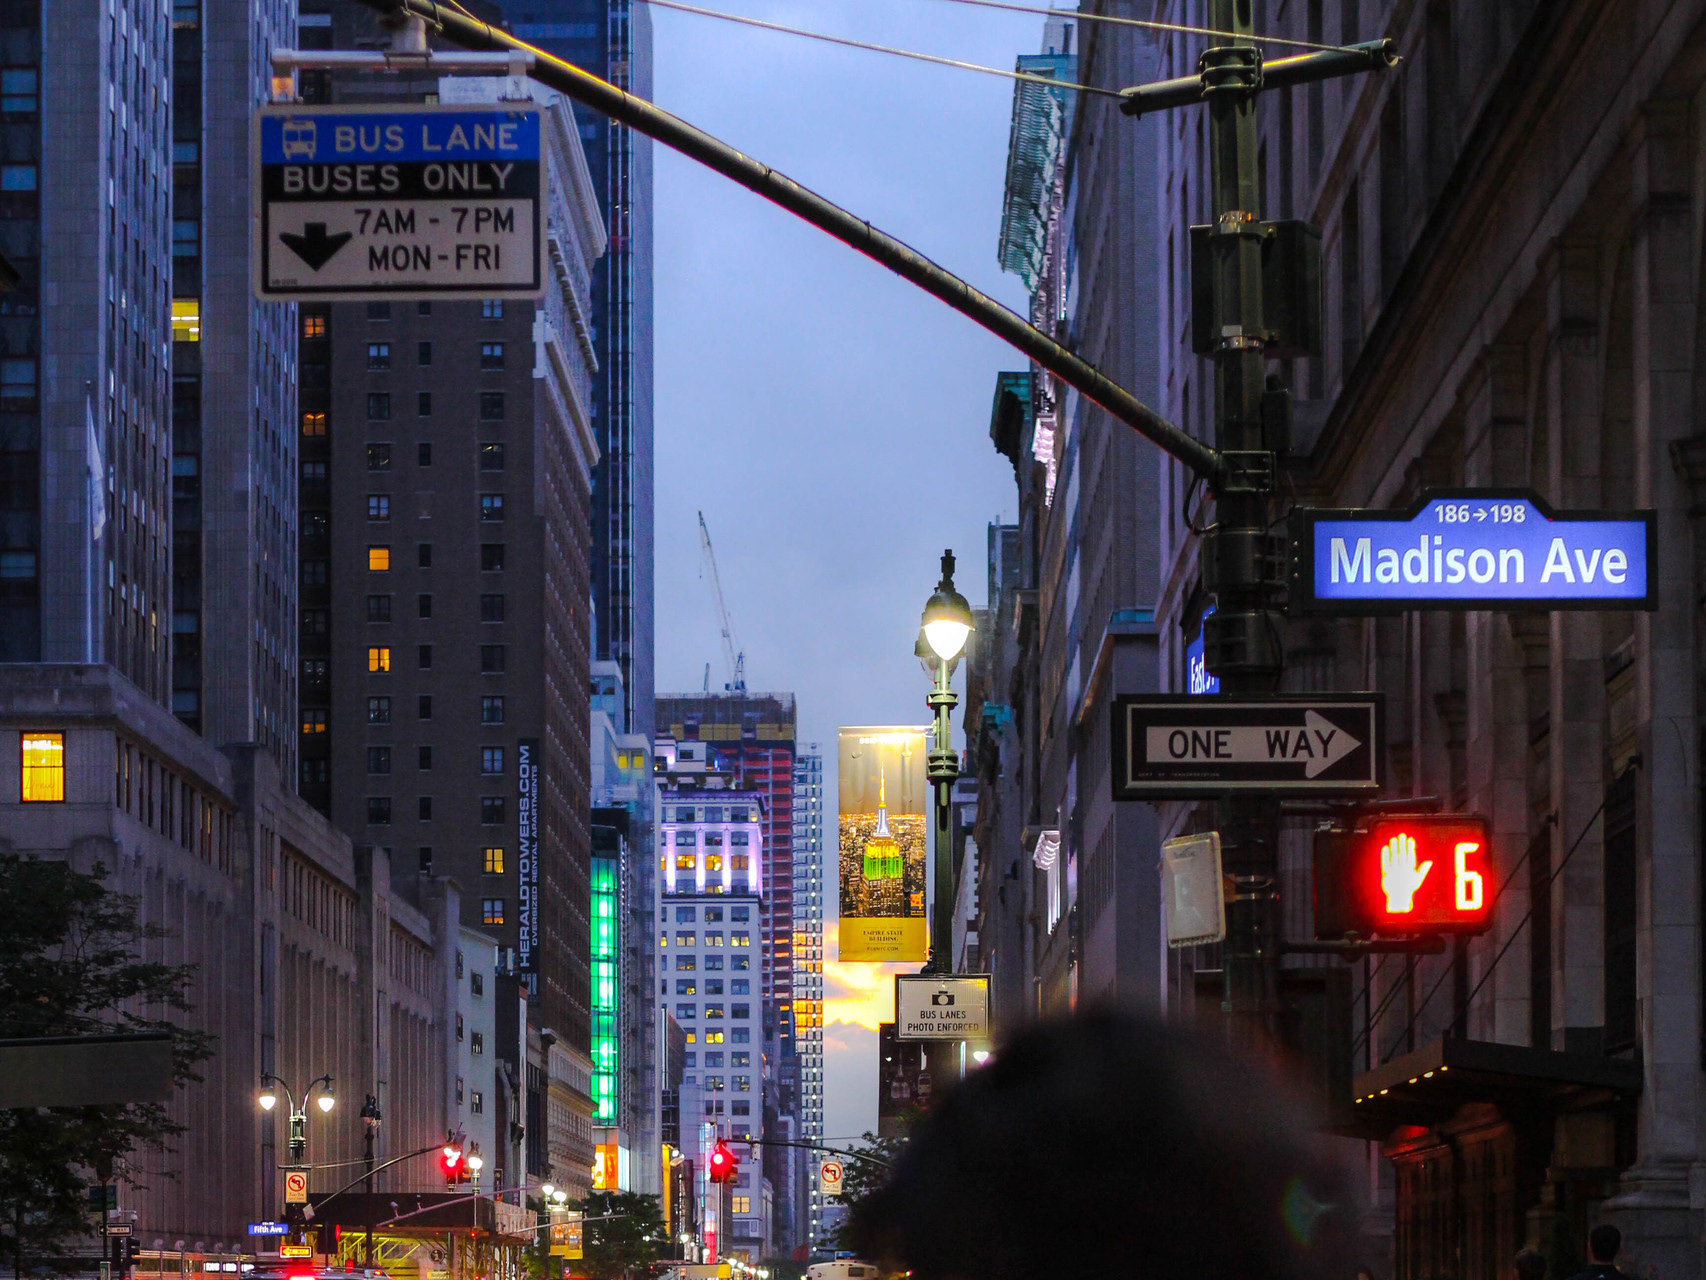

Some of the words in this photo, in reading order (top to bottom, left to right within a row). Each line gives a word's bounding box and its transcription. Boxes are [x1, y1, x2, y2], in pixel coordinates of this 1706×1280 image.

[335, 124, 405, 152] BUS
[422, 122, 519, 151] LANE
[283, 164, 400, 193] BUSES
[423, 162, 514, 191] ONLY
[354, 207, 416, 235] 7AM
[451, 206, 514, 234] 7PM
[368, 244, 500, 272] MON-FRI
[1330, 534, 1525, 584] Madison
[1540, 537, 1628, 584] Ave
[1168, 729, 1233, 759] ONE
[1265, 729, 1337, 759] WAY
[519, 745, 530, 968] HERALDTOWERS.COM
[1453, 842, 1485, 911] 6
[907, 1023, 934, 1032] PHOTO
[937, 1023, 979, 1032] ENFORCED
[920, 1010, 936, 1019] BUS
[940, 1010, 967, 1019] LANES
[253, 1225, 269, 1234] Fifth
[270, 1225, 283, 1233] Ave
